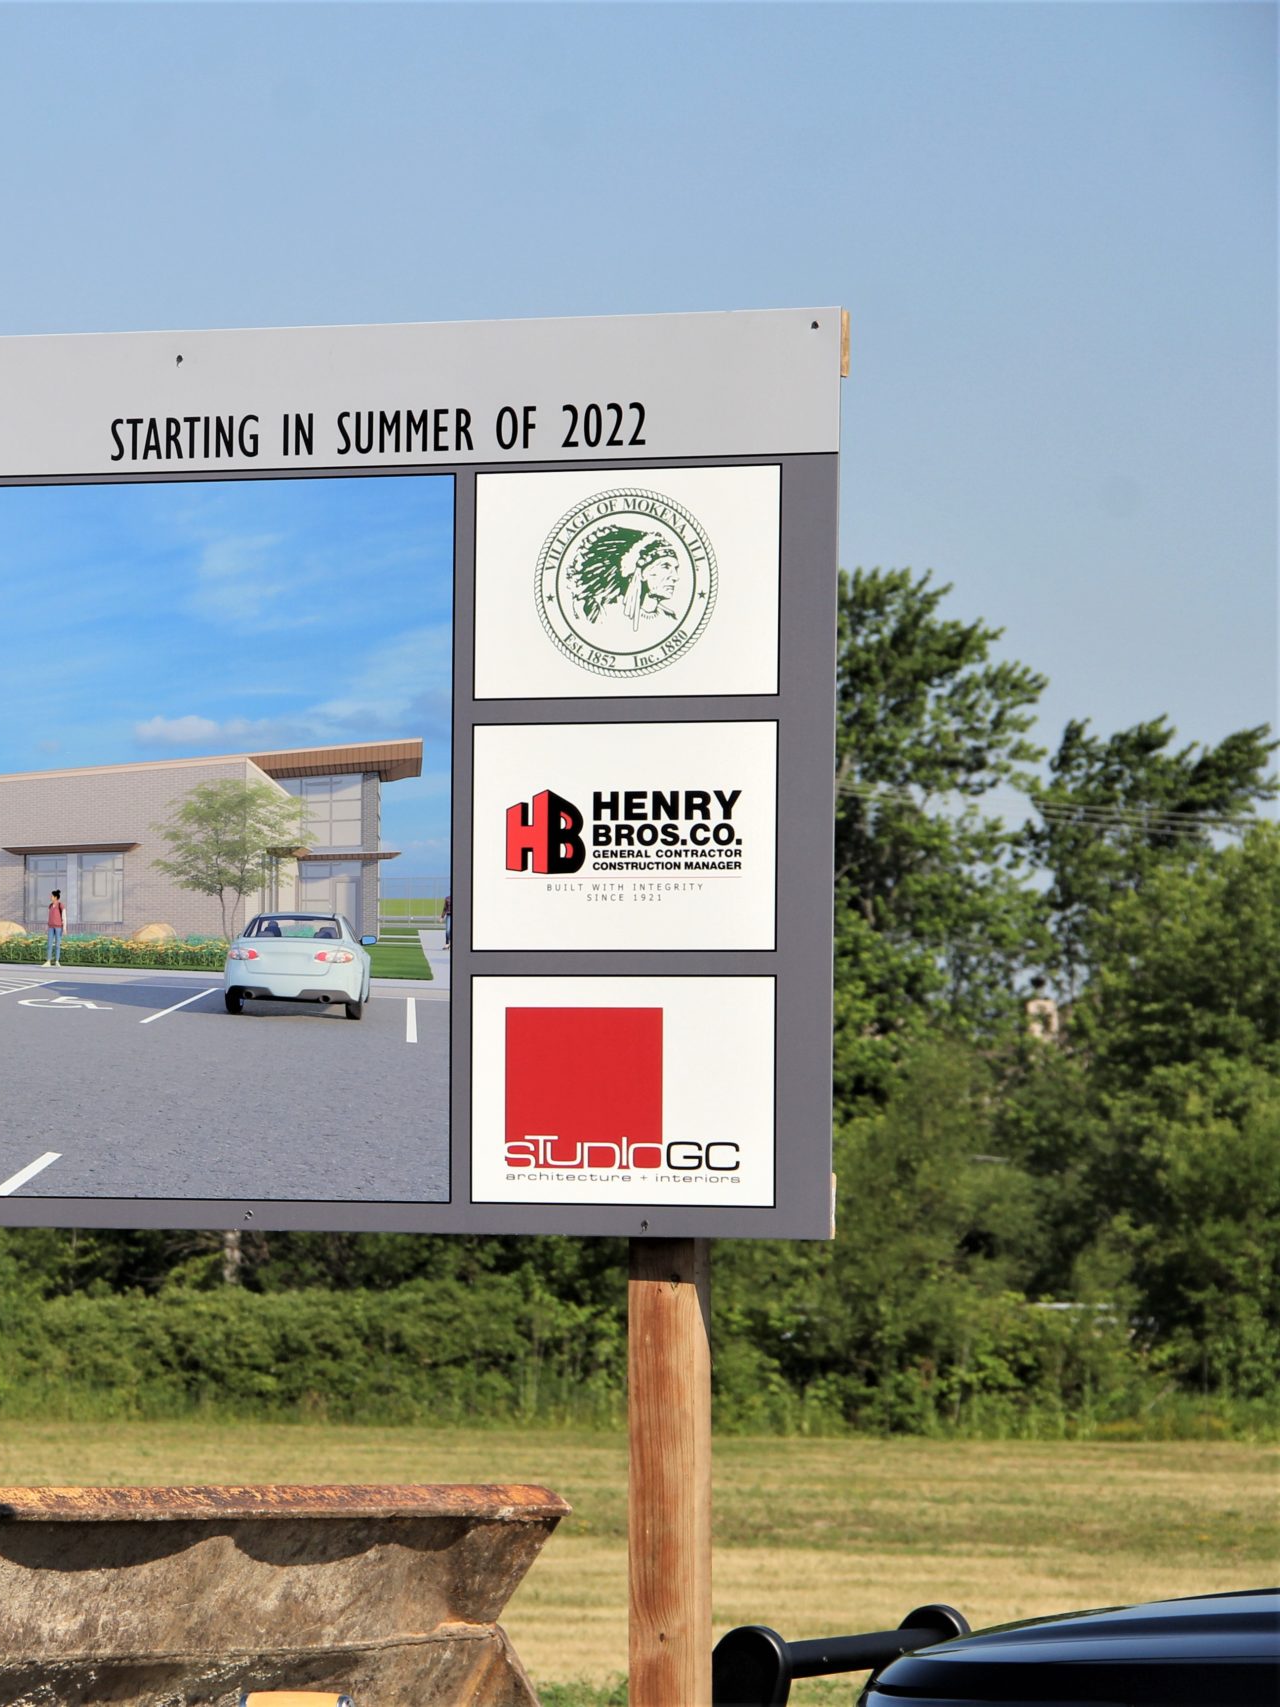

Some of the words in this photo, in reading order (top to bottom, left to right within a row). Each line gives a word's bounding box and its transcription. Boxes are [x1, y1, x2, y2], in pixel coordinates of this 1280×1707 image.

[110, 414, 260, 461] STARTING
[282, 413, 314, 457] IN
[337, 408, 474, 455] SUMMER
[496, 405, 537, 450] OF
[562, 402, 647, 448] 2022
[544, 513, 595, 571] VILLAGE
[596, 498, 619, 515] OF
[622, 498, 687, 540] MOKENA,
[563, 632, 584, 657] Est.
[587, 649, 616, 668] 1852
[633, 654, 660, 668] Inc.
[660, 629, 688, 657] 1880
[592, 790, 743, 821] HENRY
[506, 789, 586, 875] HB
[592, 823, 743, 847] BROS.CO.
[592, 849, 651, 859] GENERAL
[655, 849, 742, 858] CONTRACTOR
[592, 861, 682, 871] CONSTRUCTION
[684, 861, 742, 870] MANAGER
[546, 883, 584, 892] BUILT
[592, 883, 625, 892] WITH
[632, 883, 704, 891] INTEGRITY
[587, 894, 625, 902] SINCE
[633, 893, 663, 902] 1921
[505, 1172, 632, 1182] architecture
[655, 1173, 740, 1184] interiors
